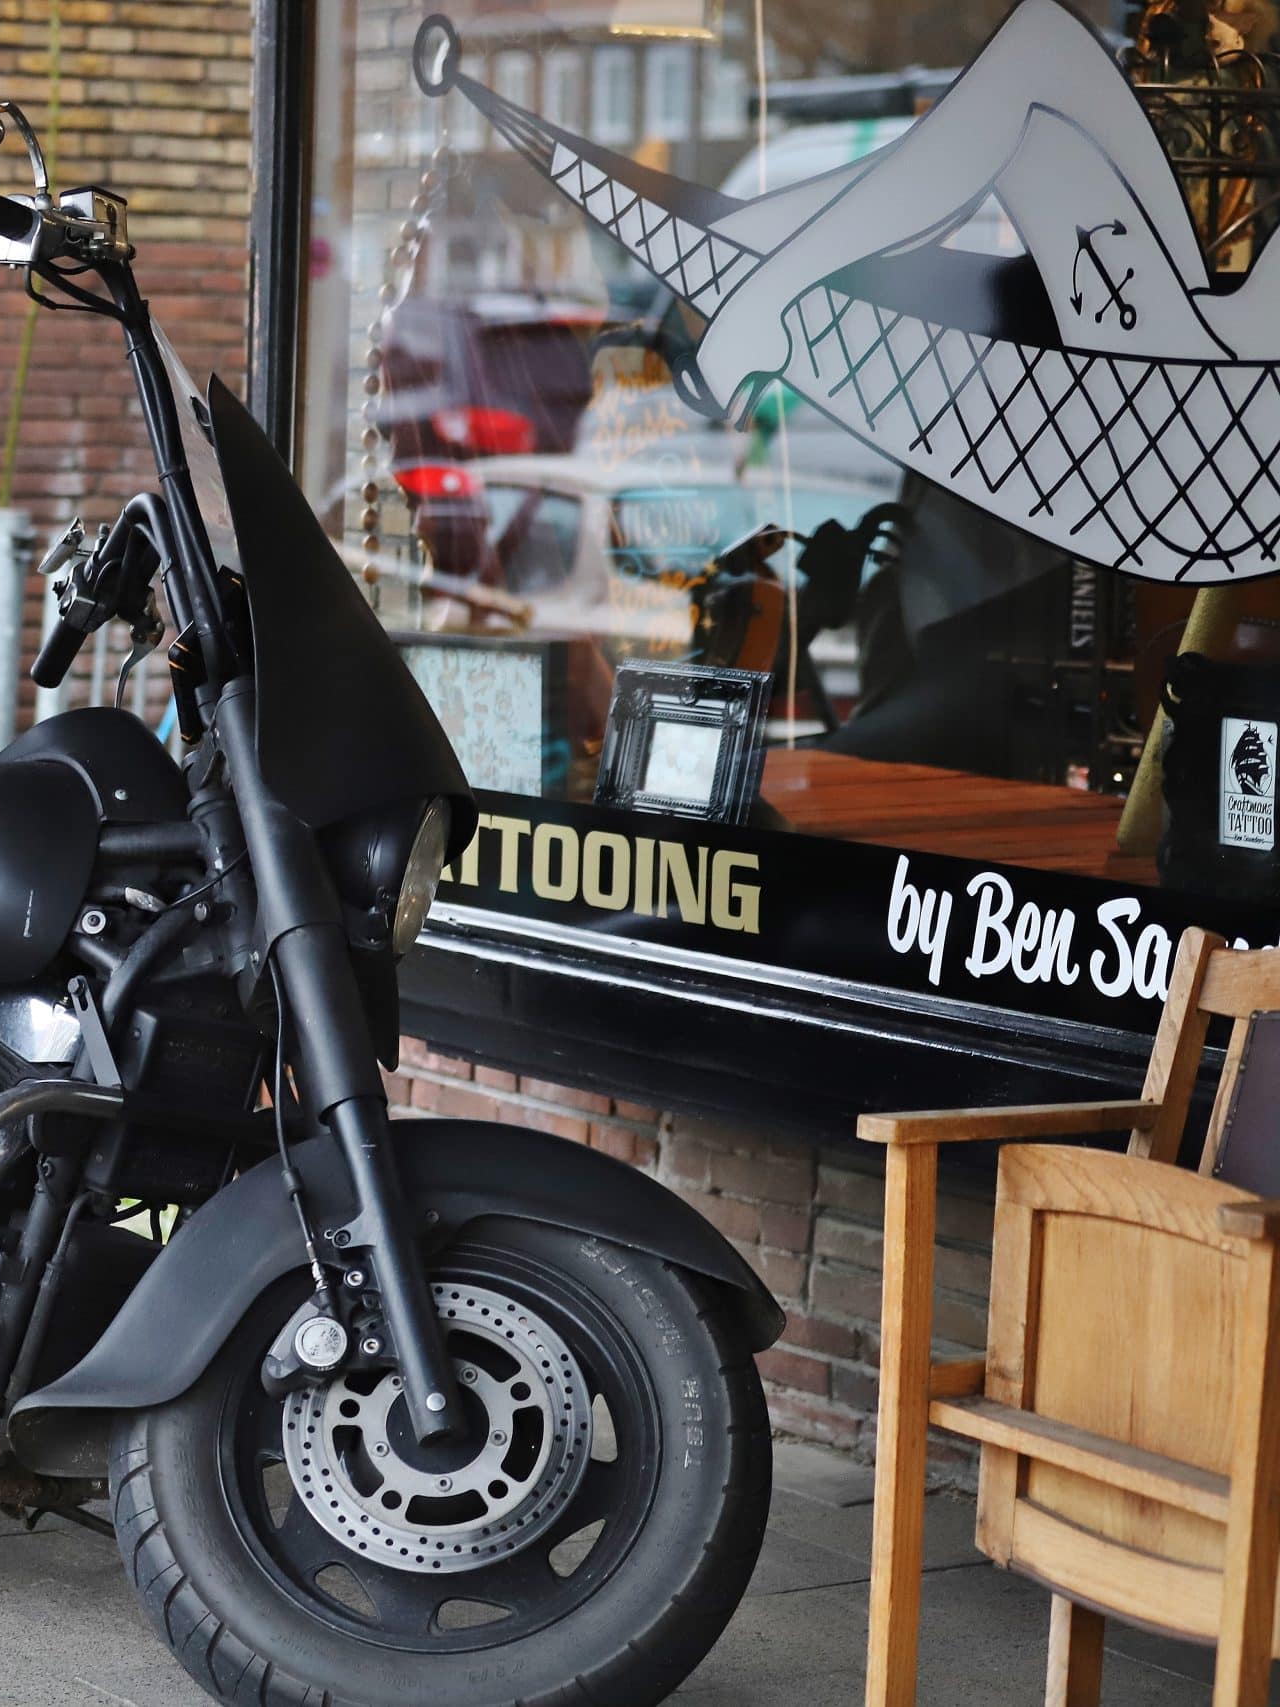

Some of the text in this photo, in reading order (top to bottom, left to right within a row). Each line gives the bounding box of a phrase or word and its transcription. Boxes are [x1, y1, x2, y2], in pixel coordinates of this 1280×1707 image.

[440, 812, 761, 934] TTOOING
[1228, 813, 1272, 835] TATTOO
[887, 854, 953, 986] by
[965, 871, 1080, 986] Ben
